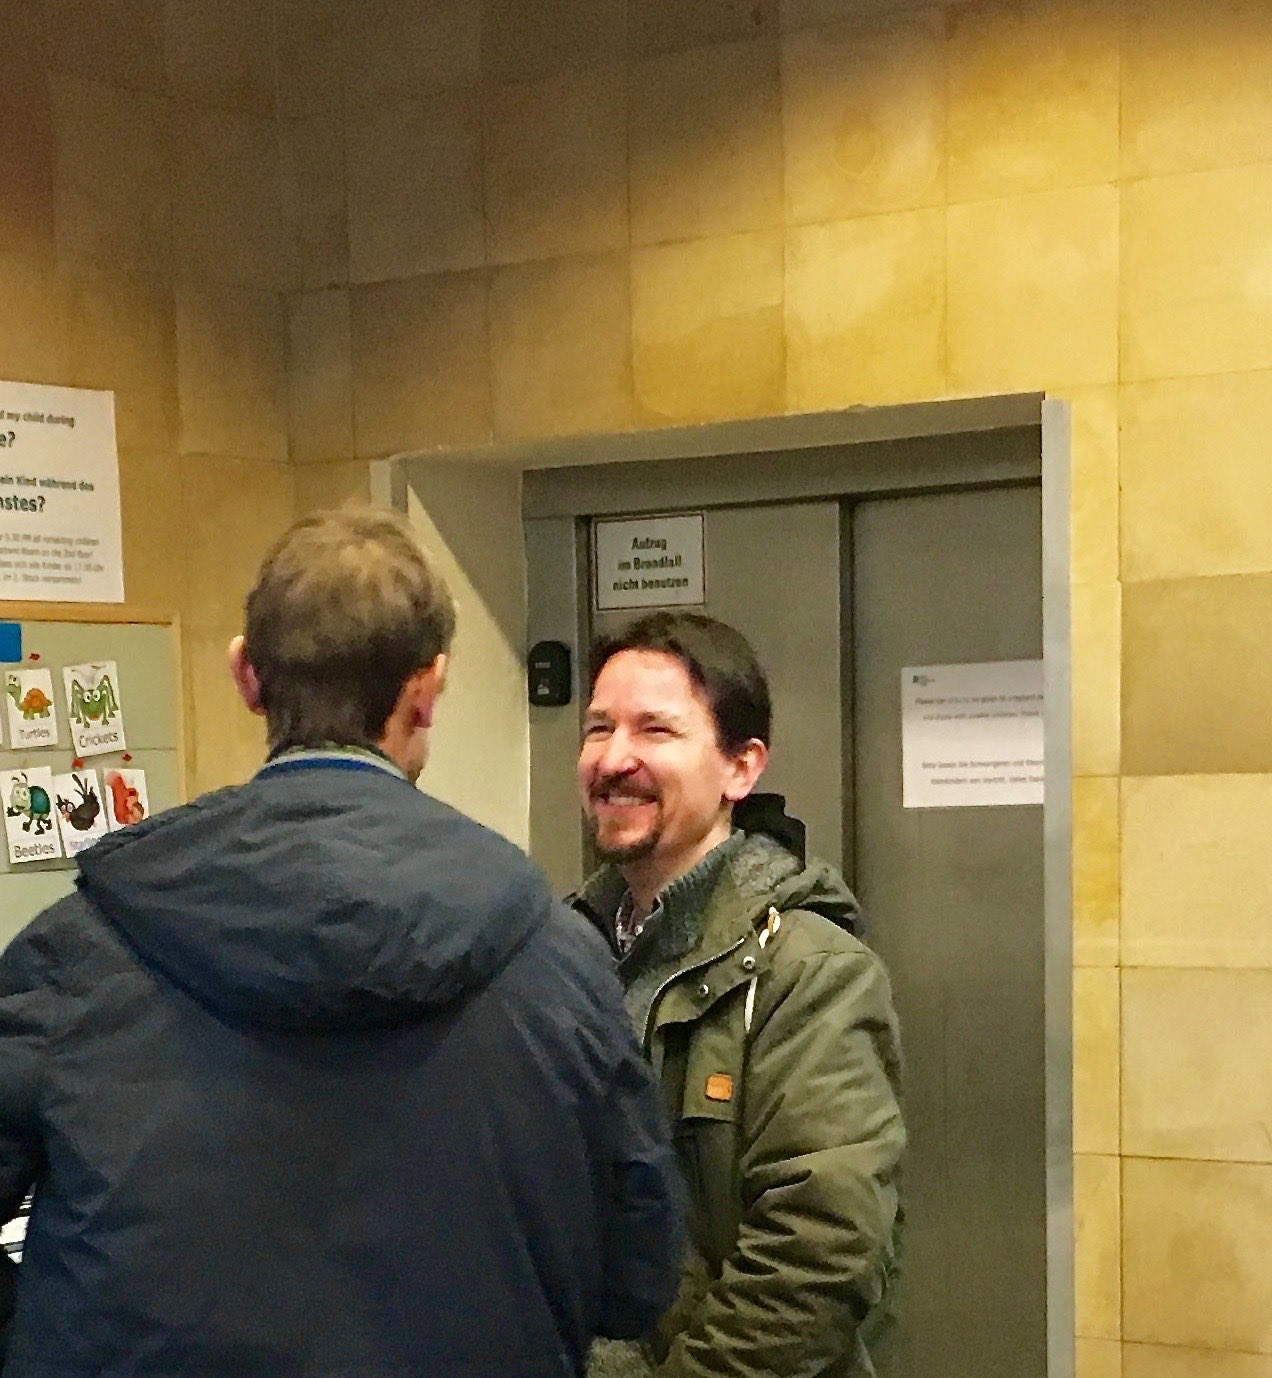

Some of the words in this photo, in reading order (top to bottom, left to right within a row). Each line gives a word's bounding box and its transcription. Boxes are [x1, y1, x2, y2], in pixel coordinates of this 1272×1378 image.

[631, 537, 667, 551] Aufzug
[633, 555, 682, 570] Brandfall
[613, 578, 639, 591] nicht
[641, 577, 689, 590] benutzen
[19, 728, 50, 740] Turtles
[78, 731, 119, 748] Crickets
[14, 843, 55, 859] Beetles
